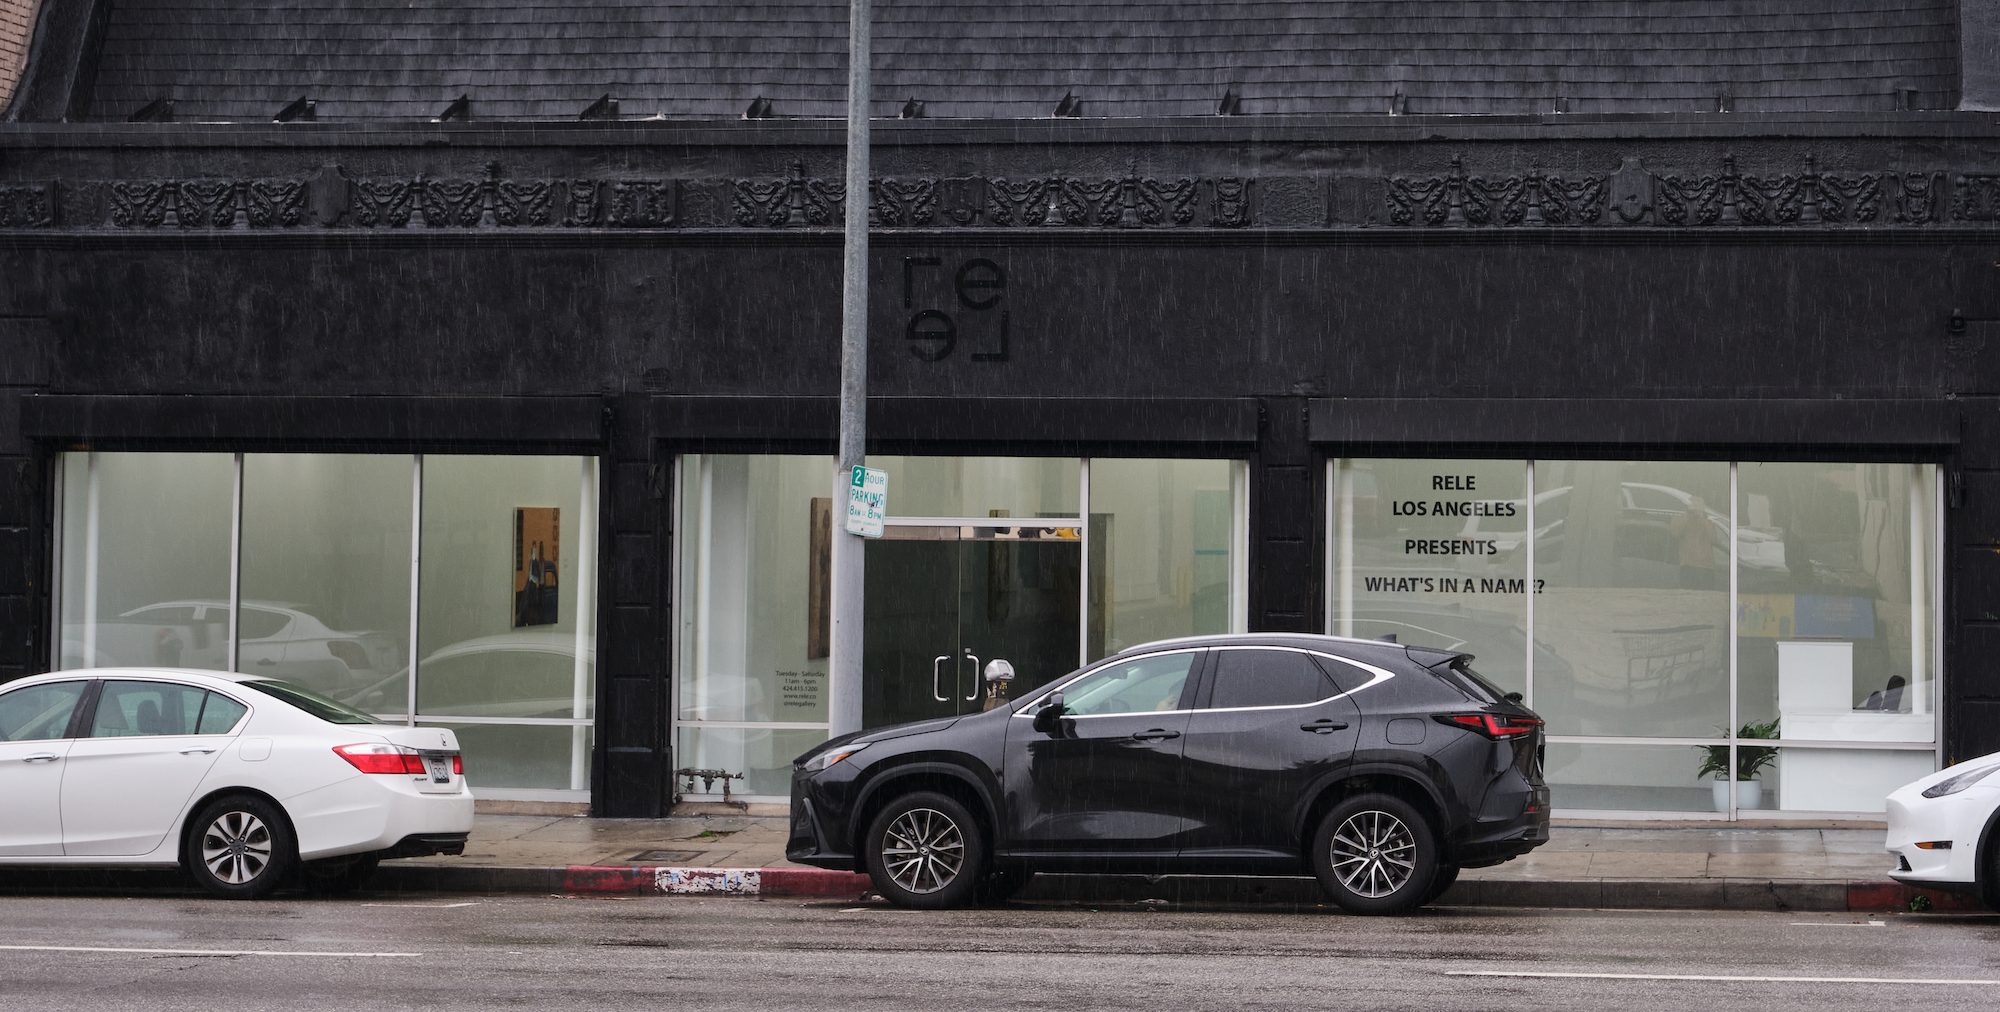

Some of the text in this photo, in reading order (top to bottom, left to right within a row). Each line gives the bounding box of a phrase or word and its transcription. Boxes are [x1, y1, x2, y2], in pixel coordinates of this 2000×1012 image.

[855, 469, 885, 485] 2 HOUR
[1432, 475, 1476, 490] RELE
[1393, 501, 1516, 517] LOS ANGELES
[1405, 539, 1498, 555] PRESENTS
[1365, 577, 1434, 593] WHAT'S
[1439, 578, 1458, 593] IN
[1463, 578, 1476, 593] A
[776, 670, 798, 678] Tuesday
